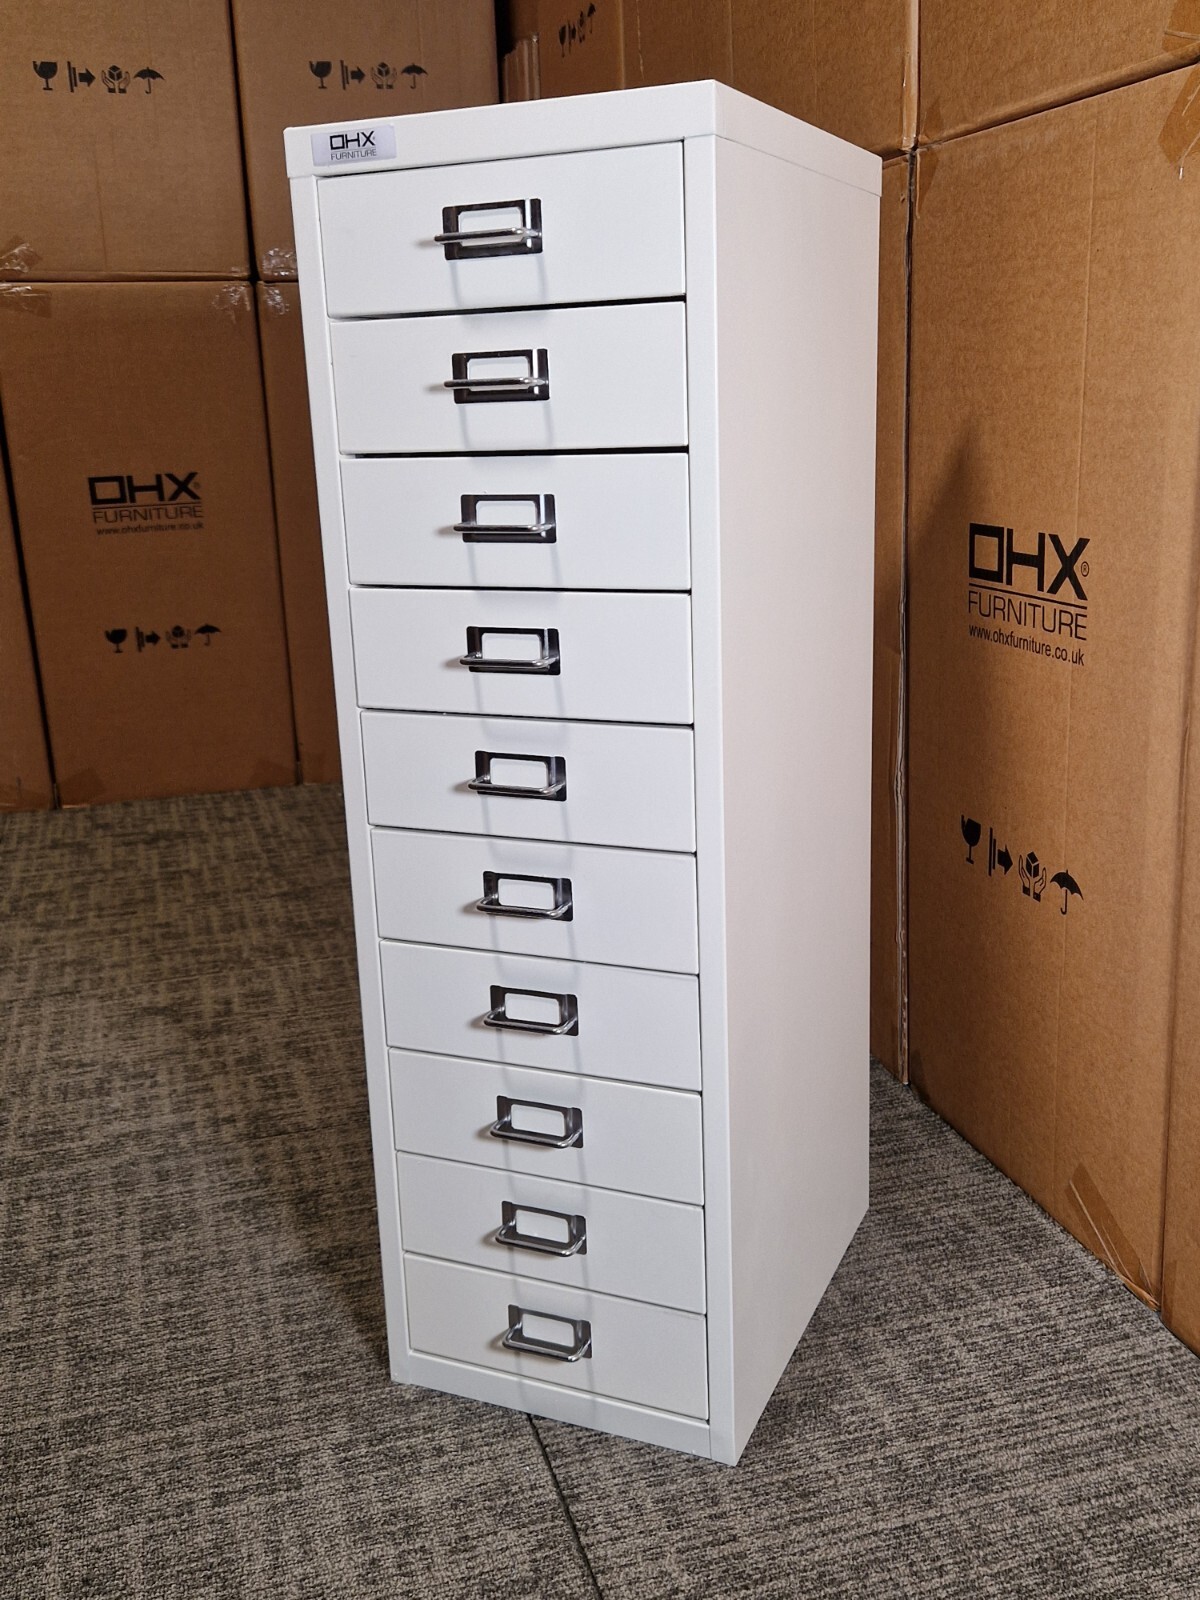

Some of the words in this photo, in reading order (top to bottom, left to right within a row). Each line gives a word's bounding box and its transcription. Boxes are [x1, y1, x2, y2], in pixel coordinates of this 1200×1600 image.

[329, 130, 376, 151] OHX
[330, 148, 377, 161] FURNITURE
[88, 472, 200, 505] OHX
[92, 505, 204, 524] FURNITURE
[968, 590, 1088, 641] FURNITURE
[968, 624, 1085, 666] www.ohxfurniture.co.uk
